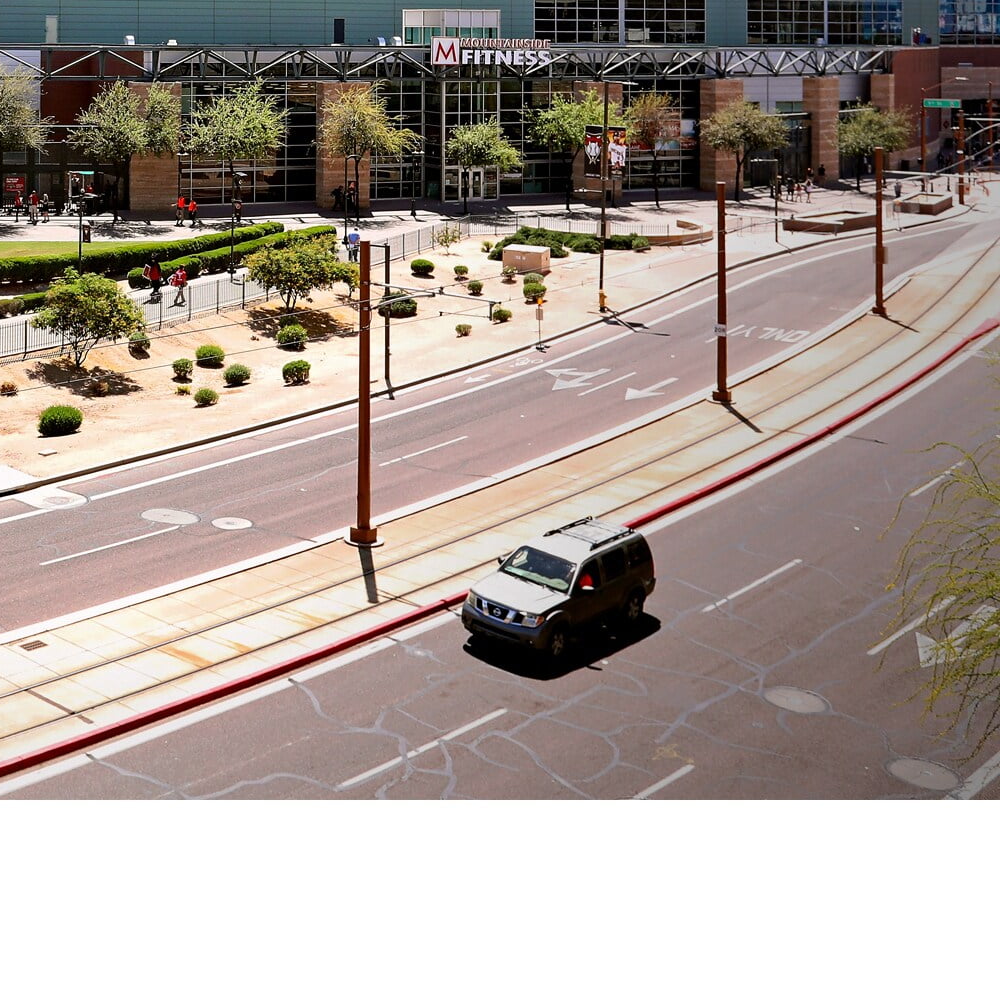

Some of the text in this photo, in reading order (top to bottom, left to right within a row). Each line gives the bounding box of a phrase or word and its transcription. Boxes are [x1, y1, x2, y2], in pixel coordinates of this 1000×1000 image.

[435, 41, 457, 63] M
[460, 38, 552, 49] MOUNTAINSIDE
[461, 49, 551, 66] FITNESS
